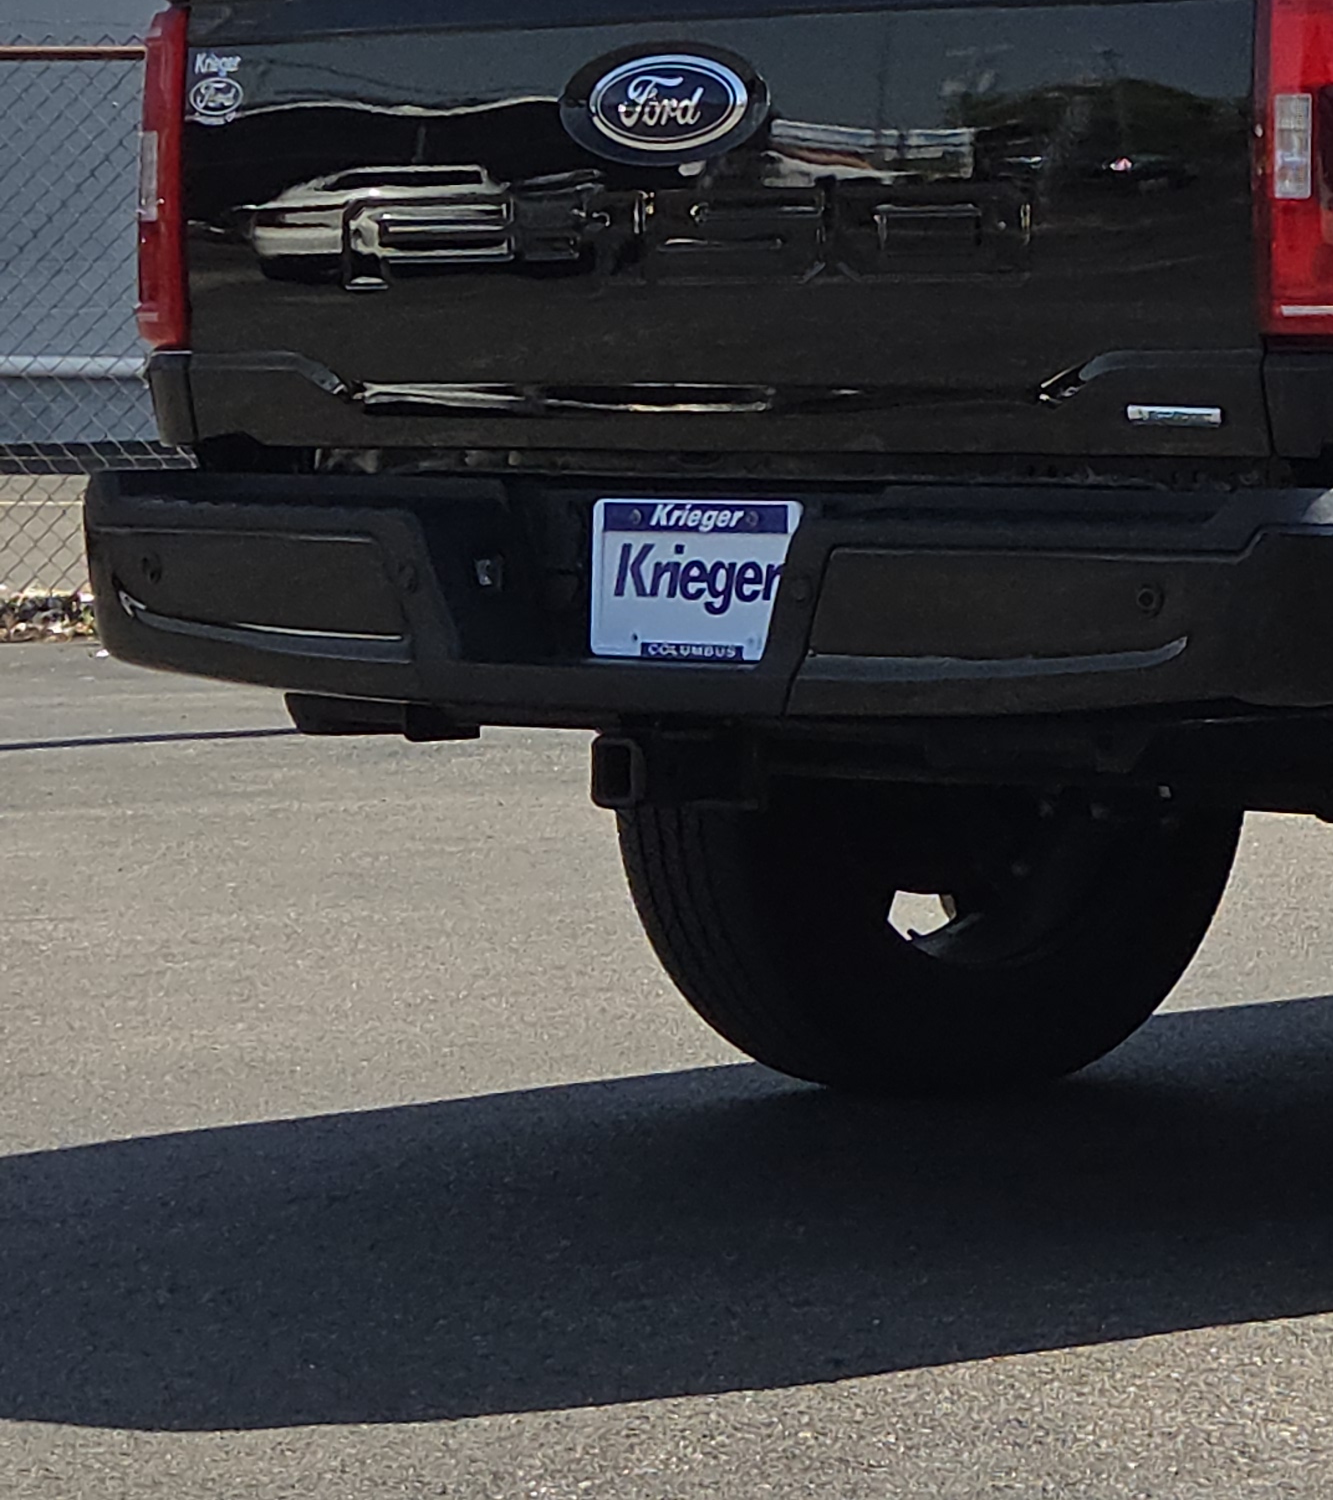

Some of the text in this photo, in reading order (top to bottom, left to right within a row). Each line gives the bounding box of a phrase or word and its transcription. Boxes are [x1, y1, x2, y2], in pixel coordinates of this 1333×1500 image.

[618, 75, 704, 127] Ford
[649, 503, 745, 532] Krieger
[613, 543, 785, 616] Krieger
[648, 643, 737, 659] COLUMBUS
